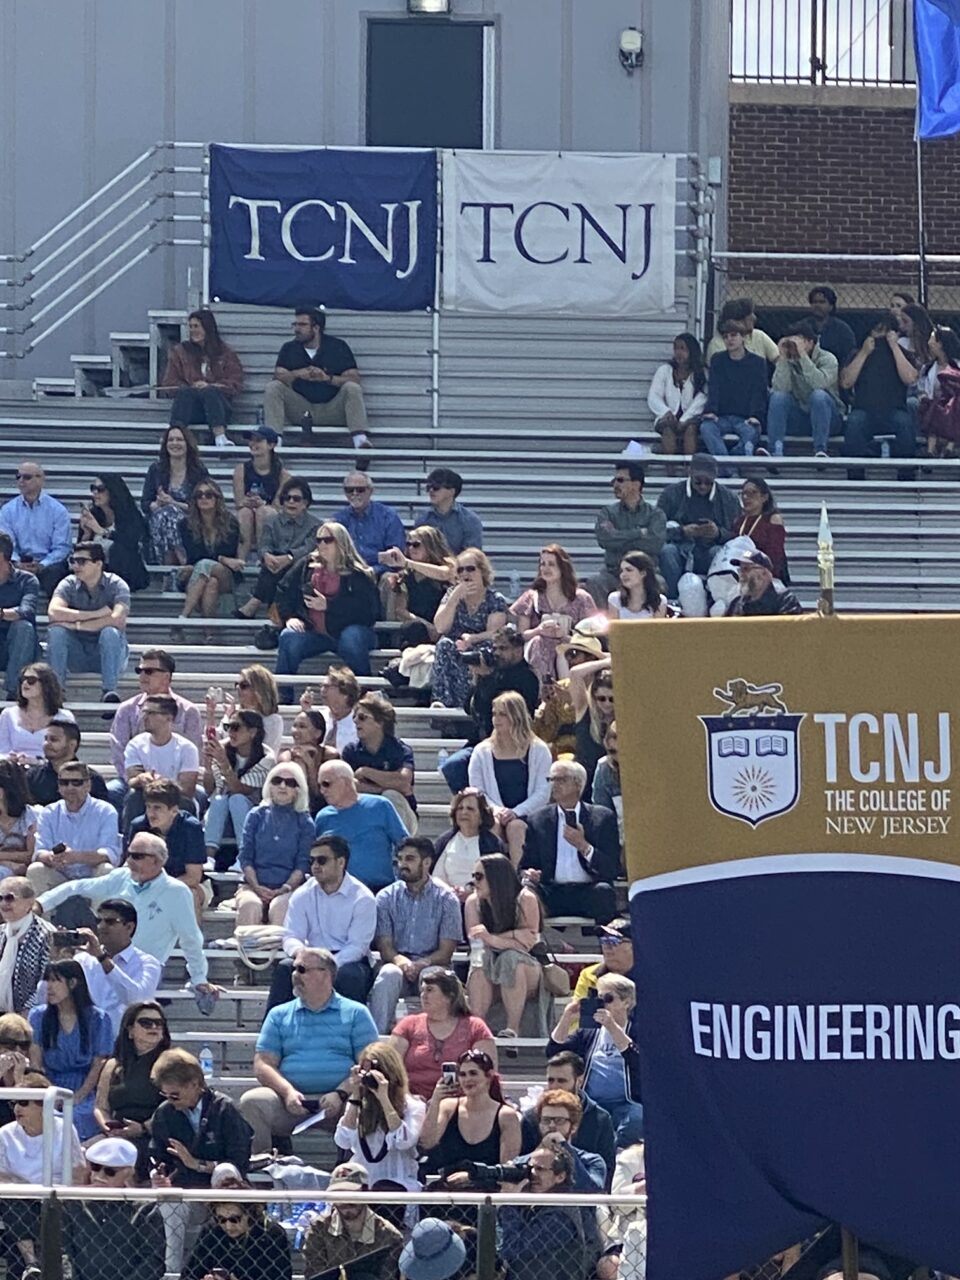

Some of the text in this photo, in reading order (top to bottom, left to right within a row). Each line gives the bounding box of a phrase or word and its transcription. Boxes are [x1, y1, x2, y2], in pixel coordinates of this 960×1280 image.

[229, 195, 422, 279] TCNJ
[460, 201, 656, 280] TCNJ
[814, 712, 951, 783] TCNJ
[825, 789, 951, 811] THE COLLEGE OF
[825, 816, 952, 838] NEW JERSEY
